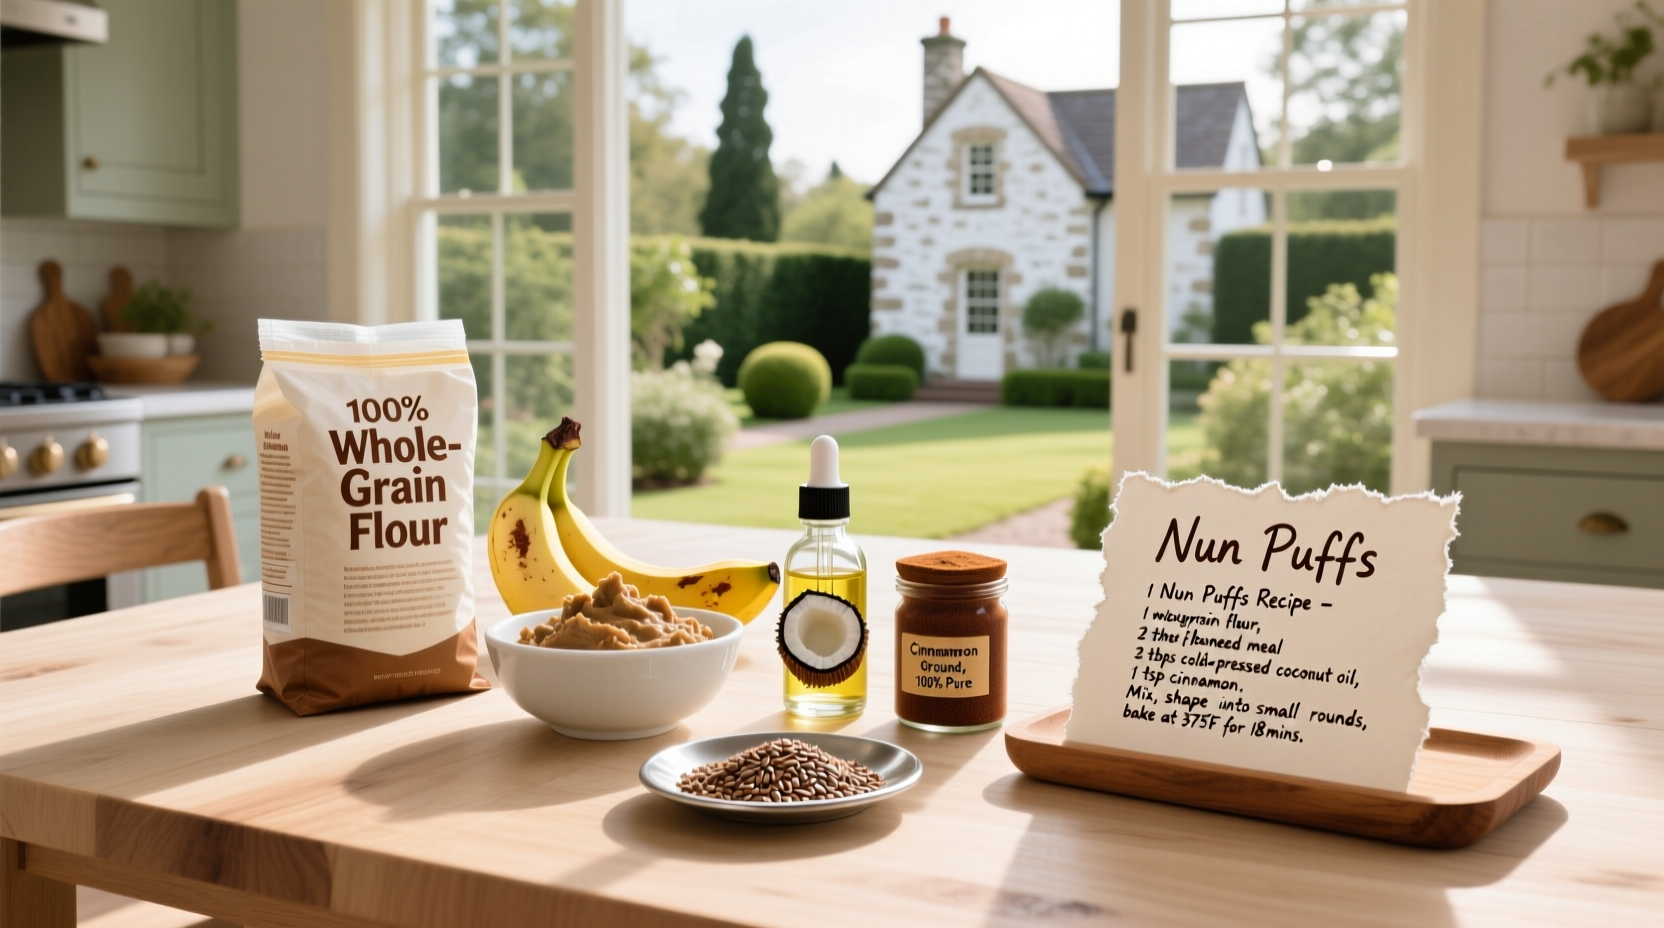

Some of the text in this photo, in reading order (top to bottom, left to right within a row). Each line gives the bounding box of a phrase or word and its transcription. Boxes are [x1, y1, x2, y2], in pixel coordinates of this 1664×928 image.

[346, 395, 429, 423] 100%
[328, 426, 461, 465] Whole-
[340, 465, 446, 507] Grain
[350, 511, 448, 550] Flour
[1155, 515, 1377, 586] Nun Puffs
[1160, 582, 1193, 600] Nun
[1202, 584, 1249, 610] Puffs
[1256, 588, 1312, 616] Recipe
[1137, 626, 1148, 640] 2
[1247, 638, 1283, 655] meal
[915, 675, 972, 689] 100% Pure
[920, 660, 966, 675] Ground,
[1134, 646, 1144, 660] 2
[1147, 647, 1176, 668] tbps
[1276, 664, 1333, 683] coconut
[1336, 669, 1359, 689] oil,
[1142, 666, 1165, 687] tsp
[1169, 671, 1243, 692] cinnamon.
[1123, 703, 1156, 721] bake
[1161, 710, 1177, 725] at
[1181, 712, 1221, 730] 375F
[1222, 716, 1246, 738] for
[1164, 689, 1208, 712] shape
[1256, 702, 1300, 720] small
[1310, 709, 1367, 731] rounds,
